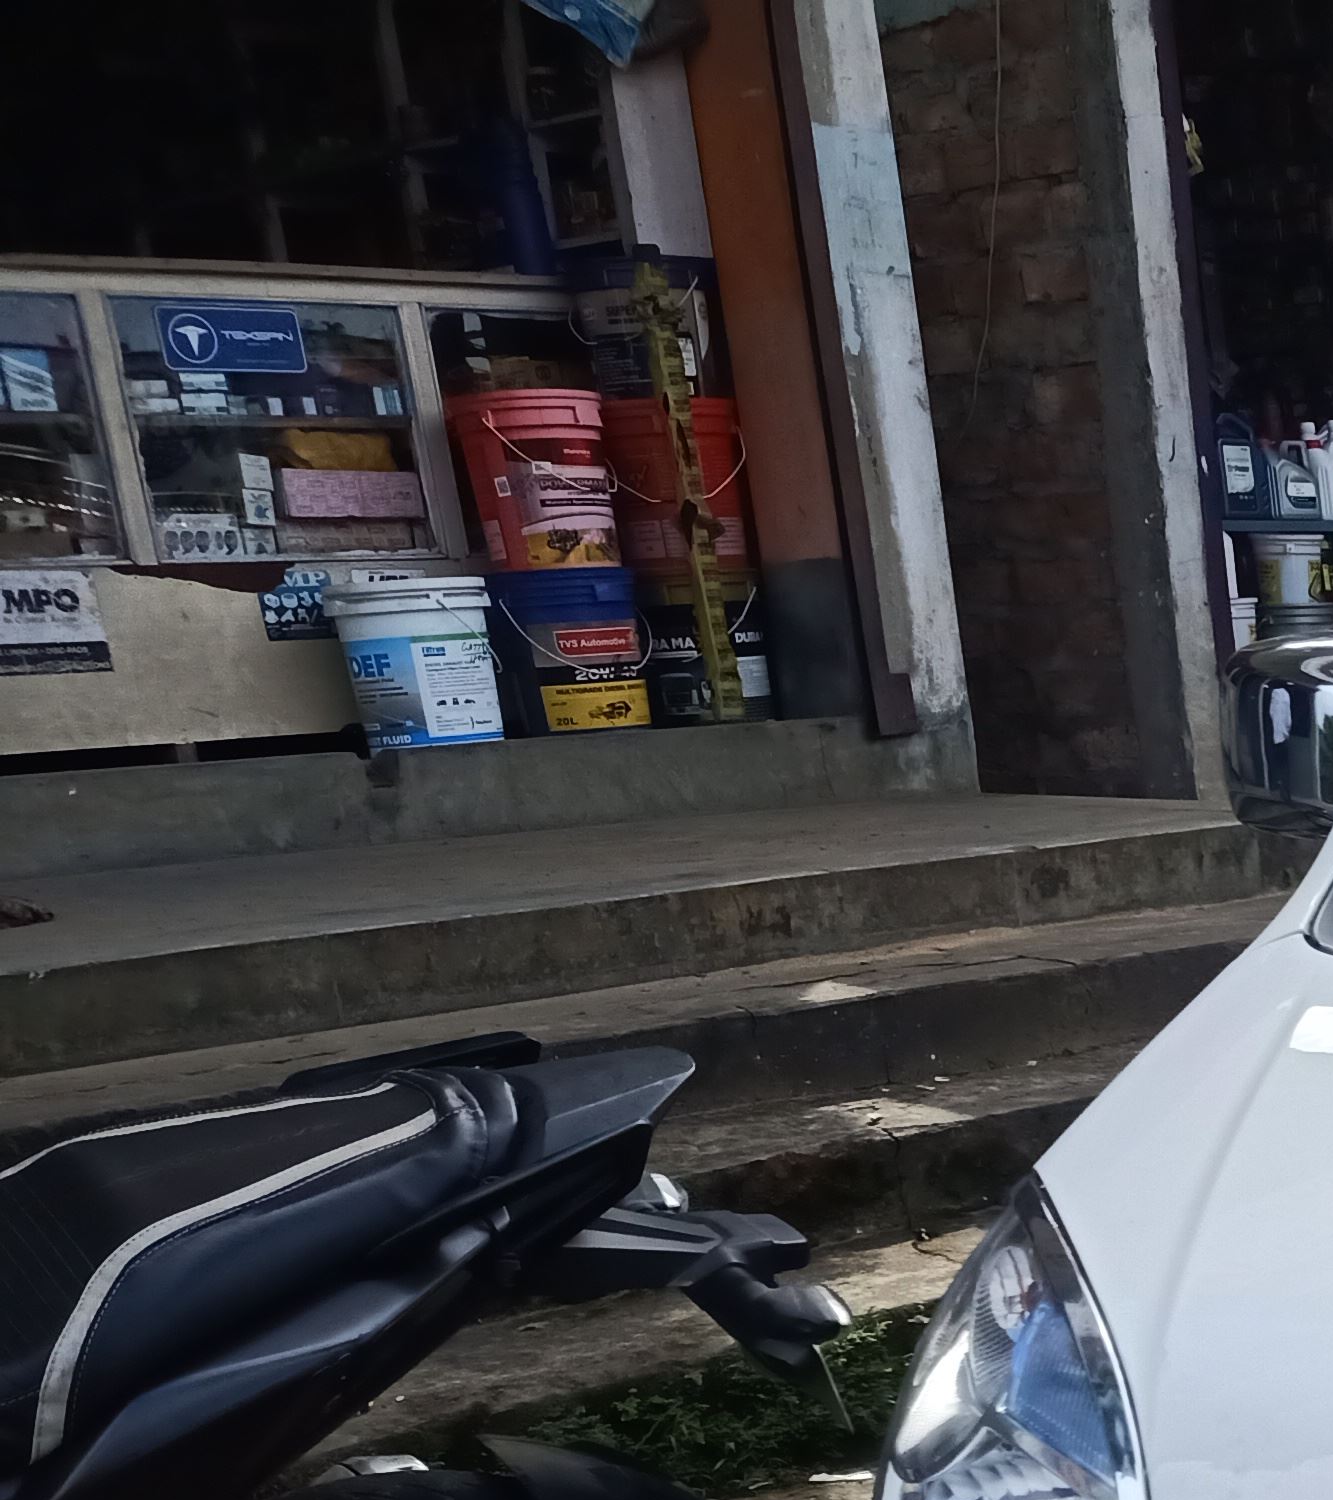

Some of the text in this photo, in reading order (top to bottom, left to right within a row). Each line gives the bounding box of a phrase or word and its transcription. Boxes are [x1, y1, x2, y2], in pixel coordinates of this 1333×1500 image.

[558, 639, 578, 648] TVS
[348, 653, 392, 679] DEF
[382, 734, 412, 745] FLUID
